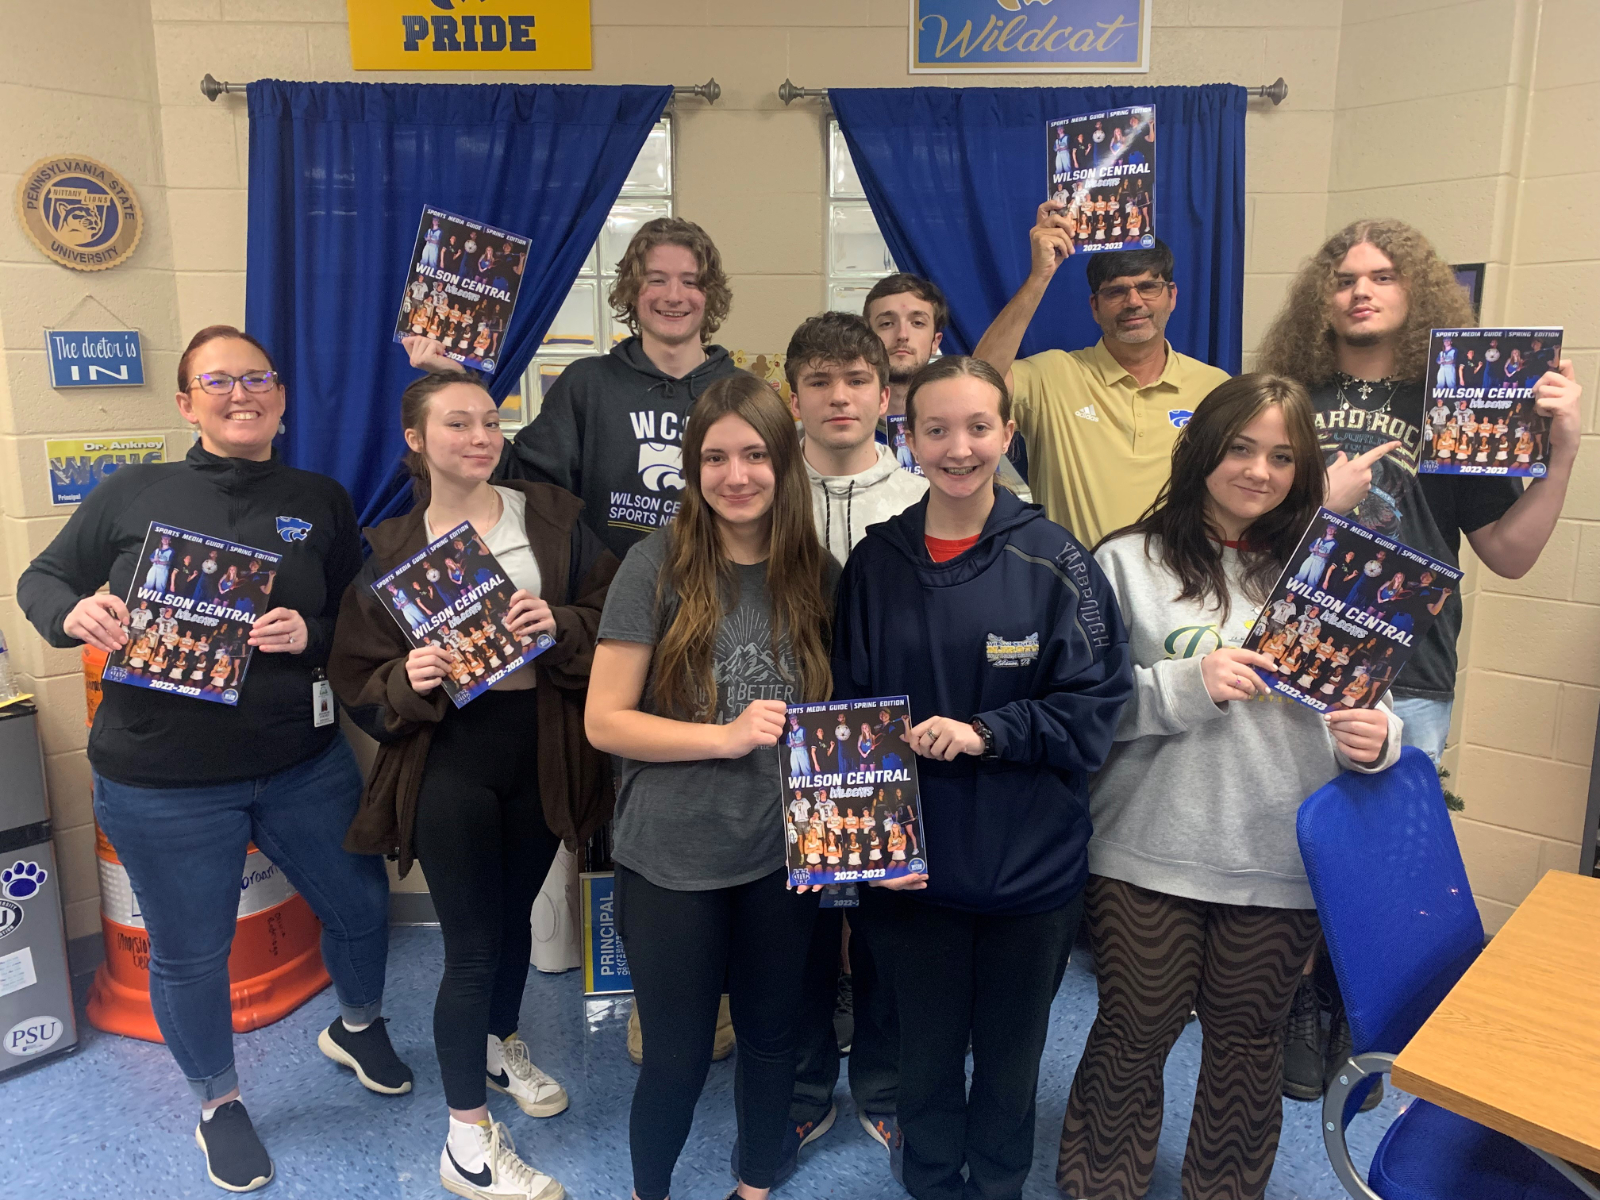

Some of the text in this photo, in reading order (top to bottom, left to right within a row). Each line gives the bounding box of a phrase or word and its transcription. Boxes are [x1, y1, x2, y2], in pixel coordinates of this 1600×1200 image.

[402, 16, 536, 51] PRIDE
[918, 14, 1138, 58] Wildcat
[1050, 119, 1068, 127] SPORTS
[1052, 163, 1150, 184] WILSON CENTRAL
[27, 161, 134, 220] PENNSYLVANIA STATE
[53, 188, 82, 197] NITTANY
[427, 209, 446, 219] SPORTS
[448, 215, 464, 225] MEDIA
[486, 228, 504, 238] SPRING
[51, 240, 118, 263] UNIVERSITY
[1082, 242, 1123, 252] 2022-2023
[416, 262, 511, 302] WILSON CENTRAL
[53, 335, 136, 360] The doctor is
[444, 352, 465, 362] -2023
[71, 365, 128, 380] IN
[1432, 388, 1534, 398] WILSON CENTR
[1075, 410, 1099, 422] adidas
[1315, 410, 1419, 447] ARD ROC
[84, 441, 163, 451] Dr. Ankney
[1460, 466, 1508, 474] 2022-2023
[610, 492, 661, 510] WILSON
[609, 507, 657, 525] SPORTS
[154, 526, 278, 563] SPORTS MEDIA GUIDE SPRING EDITION
[376, 524, 469, 589] SPORTS MEDIA GUIDE SPRING EDITION
[1321, 512, 1459, 580] SPORTS MEDIA GUIDE SPRING EDITION
[137, 587, 257, 625] WILSON CENTRAL
[412, 574, 505, 640] WILSON CENTRAL
[1285, 577, 1415, 647] WILSON CENTRAL
[485, 656, 524, 686] 2022-2023
[149, 680, 201, 696] 2022-2023
[738, 682, 796, 704] BETTER
[1274, 680, 1328, 711] 2022-2023
[788, 769, 911, 789] WILSON CENTRAL
[834, 868, 886, 880] 2022-2023
[600, 891, 614, 975] PRINCIPAL
[12, 1022, 56, 1048] PSU
